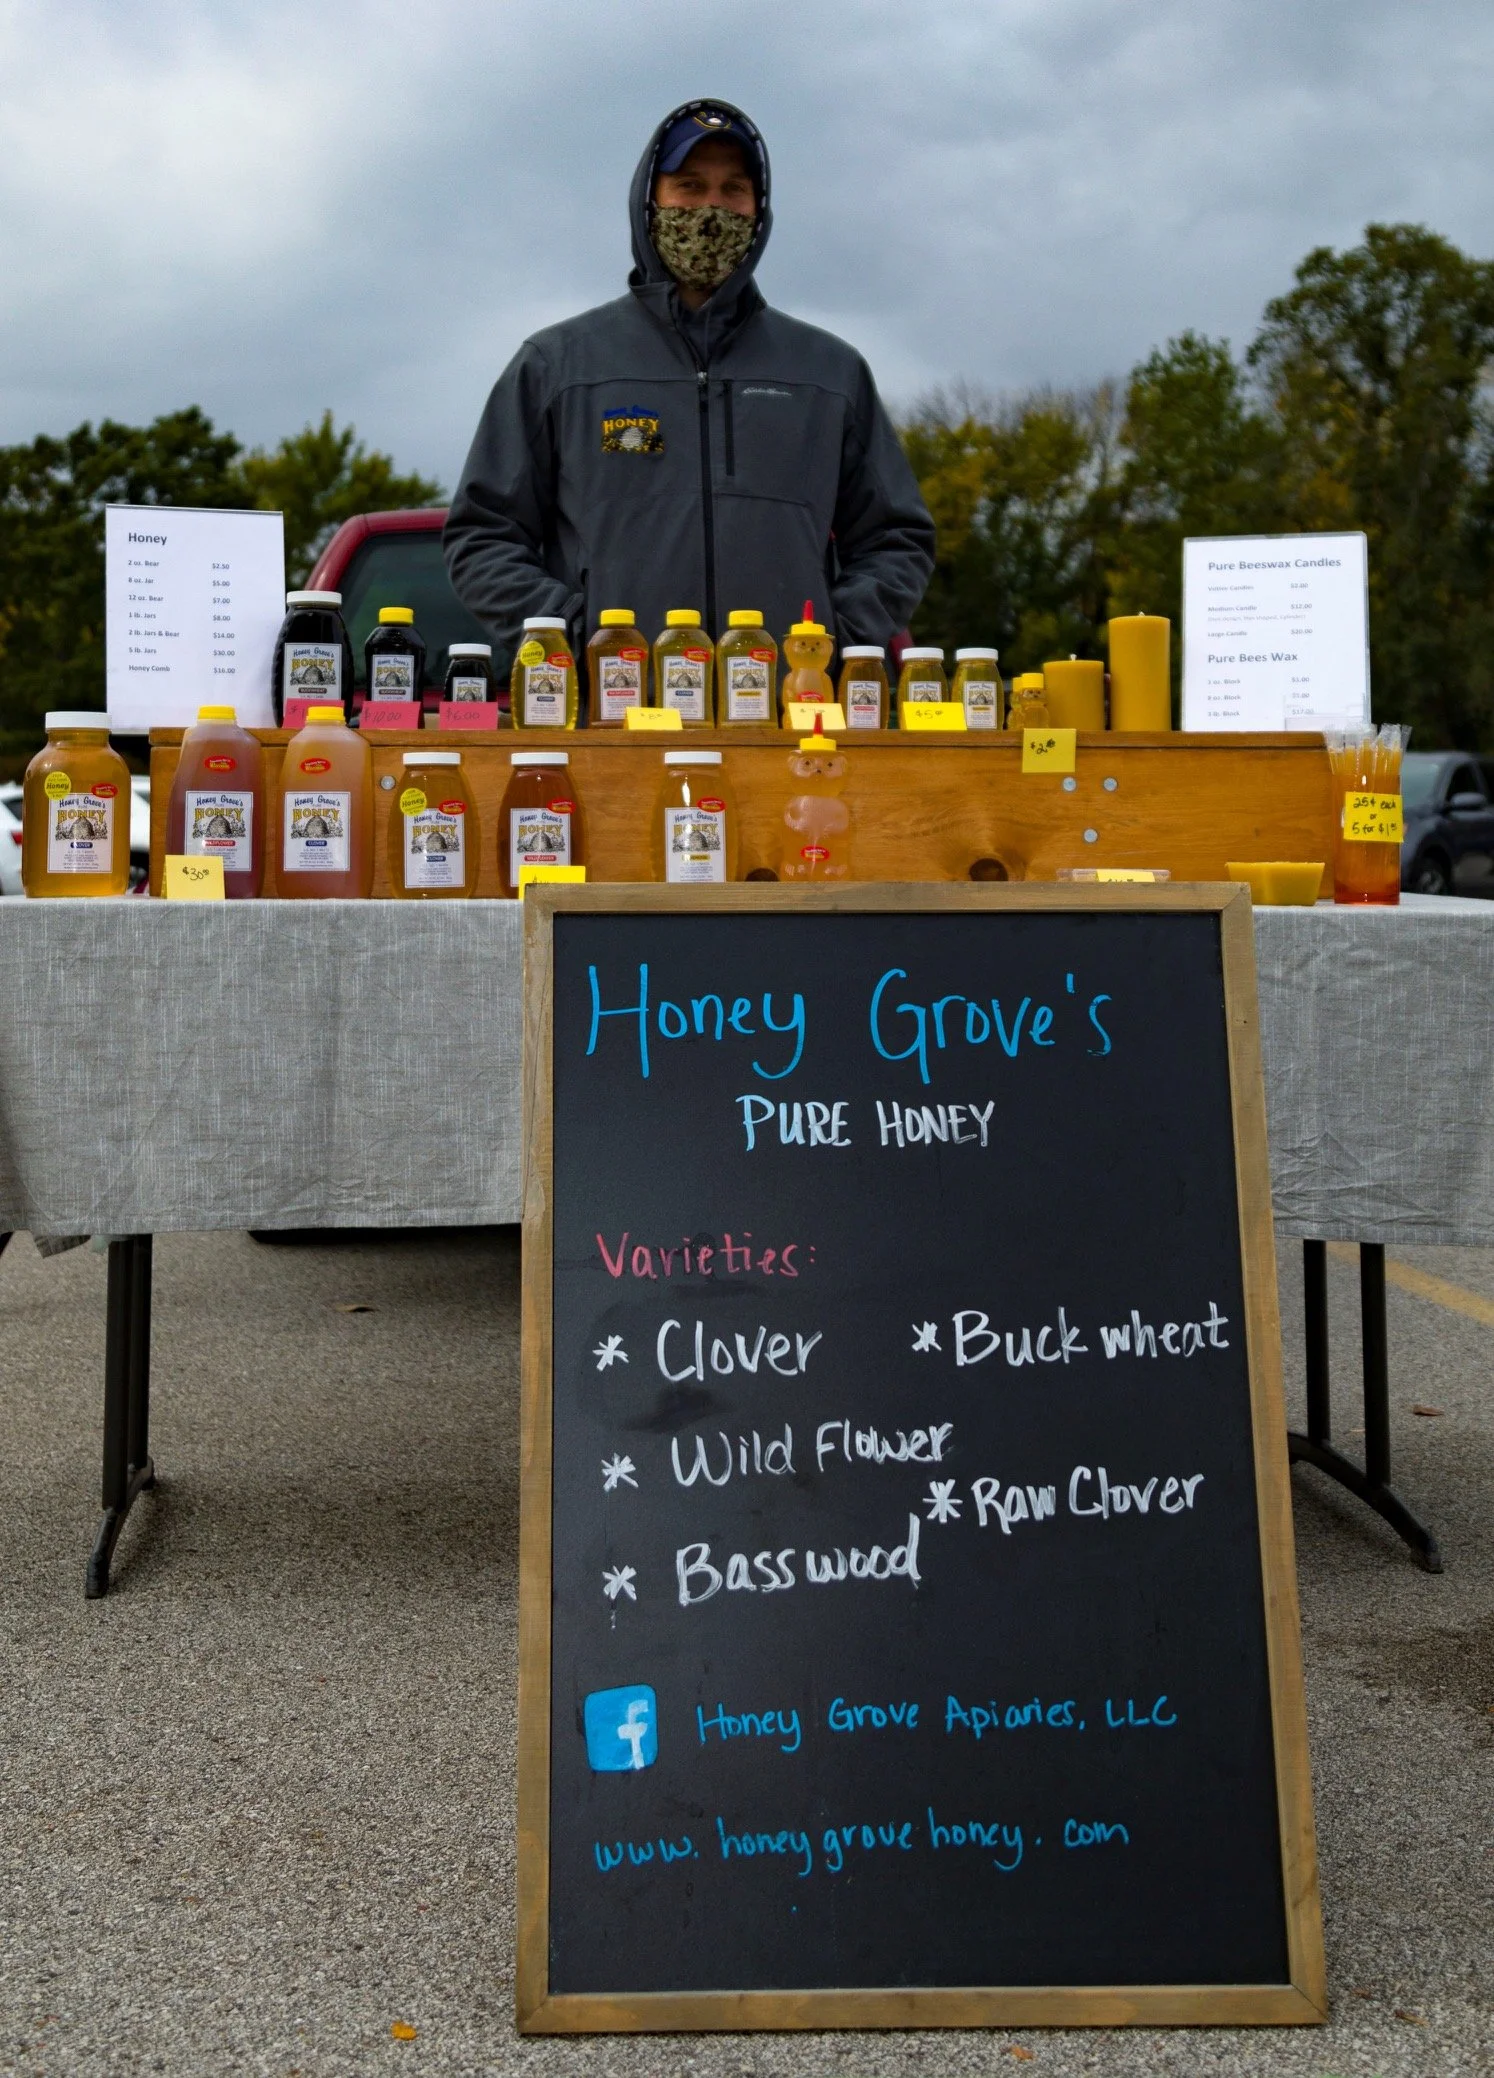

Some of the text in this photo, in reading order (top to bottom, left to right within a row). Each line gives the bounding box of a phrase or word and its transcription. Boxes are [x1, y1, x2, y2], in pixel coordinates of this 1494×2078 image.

[603, 418, 659, 434] HONEY
[128, 532, 168, 546] Honey
[1208, 557, 1342, 571] Pure Beeswax Candles
[212, 597, 231, 605] $7.00
[144, 612, 157, 620] Jars
[213, 614, 231, 622] $8.00
[213, 632, 236, 640] $14.00
[144, 647, 158, 655] Jars
[213, 649, 236, 657] $30.00
[293, 647, 335, 658] Honey Grove's
[1208, 652, 1298, 664] Pure Bees Wax
[129, 664, 171, 673] Honey Comb
[214, 667, 236, 675] $16.00
[291, 658, 335, 672] HONEY
[376, 666, 409, 676] HONEY
[529, 673, 563, 683] HONEY
[603, 668, 637, 678] HONEY
[668, 668, 701, 678] HONEY
[457, 686, 483, 694] HONEY
[46, 782, 70, 791] Honey
[59, 796, 106, 809] Honey Grove's
[196, 794, 244, 807] Honey Grove's
[294, 794, 341, 807] Honey Grove's
[401, 798, 425, 808] Honey
[1380, 798, 1397, 810] each
[56, 808, 107, 825] HONEY
[194, 807, 245, 823] HONEY
[292, 807, 341, 823] HONEY
[413, 812, 457, 824] Honey Grove's
[519, 814, 538, 824] Honey
[674, 813, 693, 823] Honey
[412, 824, 458, 839] HONEY
[518, 824, 564, 840] HONEY
[1352, 822, 1360, 835] 5
[1362, 824, 1376, 835] for
[586, 963, 1113, 1084] Honey Grove's
[735, 1094, 994, 1151] PURE HONEY
[596, 1231, 817, 1280] Varieties:
[657, 1320, 823, 1382] Clover
[671, 1418, 954, 1487] Wild Flower
[971, 1465, 1205, 1534] Raw Clover
[696, 1701, 801, 1752] Honey
[828, 1697, 919, 1734] Grove
[1107, 1695, 1178, 1728] LLC
